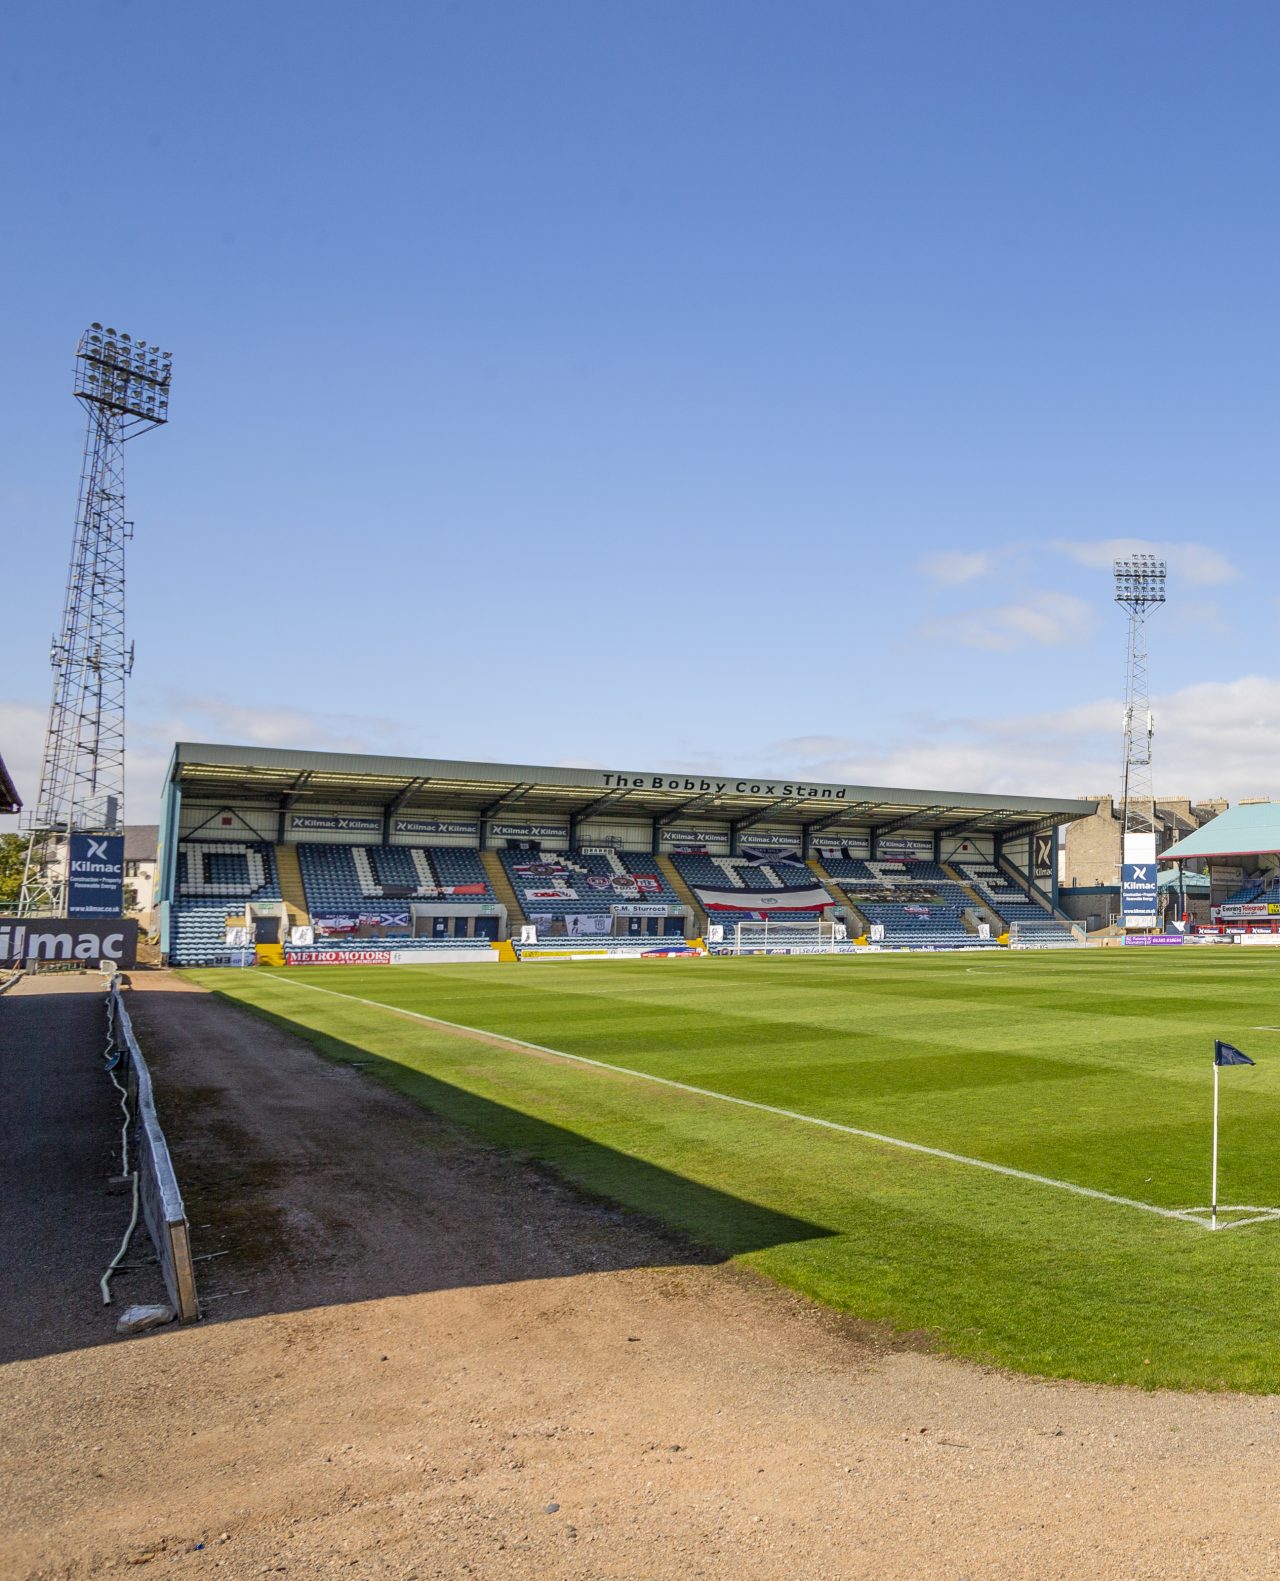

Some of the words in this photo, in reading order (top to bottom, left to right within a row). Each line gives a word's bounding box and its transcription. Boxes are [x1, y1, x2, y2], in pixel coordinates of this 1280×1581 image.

[602, 774, 644, 787] The
[652, 777, 726, 793] Bobby
[735, 781, 775, 795] Cox
[782, 785, 847, 799] Stand
[304, 819, 336, 828] Kilmac
[349, 820, 380, 829] Kilmac
[407, 823, 436, 832] Kilmac
[448, 824, 477, 833] Kilmac
[502, 826, 529, 835] Kilmac
[541, 828, 567, 836] Kilmac
[671, 832, 695, 840] Kilmac
[748, 836, 770, 844] Kilmac
[778, 837, 801, 845] Kilmac
[819, 838, 840, 846] Kilmac
[848, 839, 869, 848] Kilmac
[885, 840, 906, 849] Kilmac
[913, 841, 932, 850] Kilmac
[71, 861, 121, 873] Kilmac
[1123, 882, 1155, 890] Kilmac
[1222, 905, 1242, 914] Evening
[1242, 904, 1267, 912] Telegraph
[291, 951, 337, 961] METRO
[338, 950, 390, 960] MOTORS
